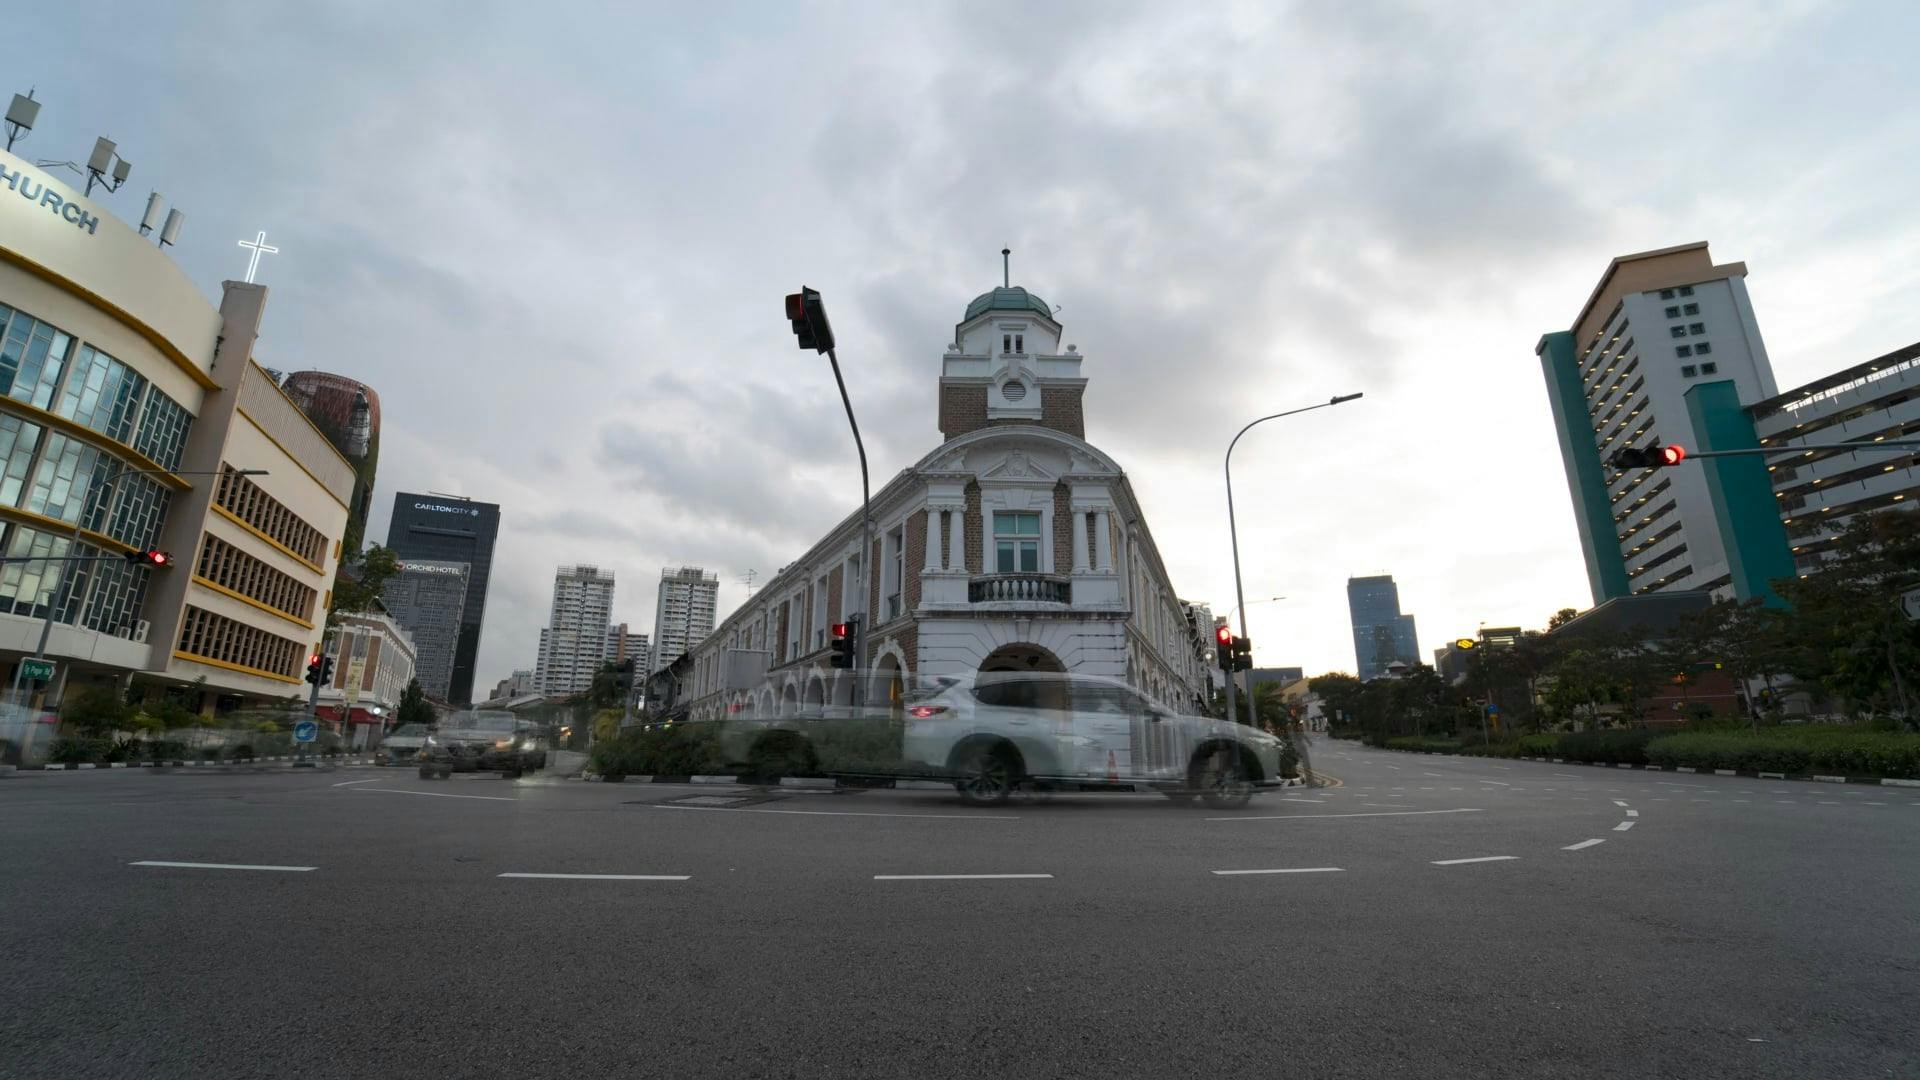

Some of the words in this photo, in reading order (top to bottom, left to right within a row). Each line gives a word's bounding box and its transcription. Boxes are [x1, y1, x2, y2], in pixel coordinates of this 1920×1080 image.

[0, 163, 99, 235] HURCH
[406, 564, 435, 573] ORCHID
[436, 567, 460, 575] HOTEL
